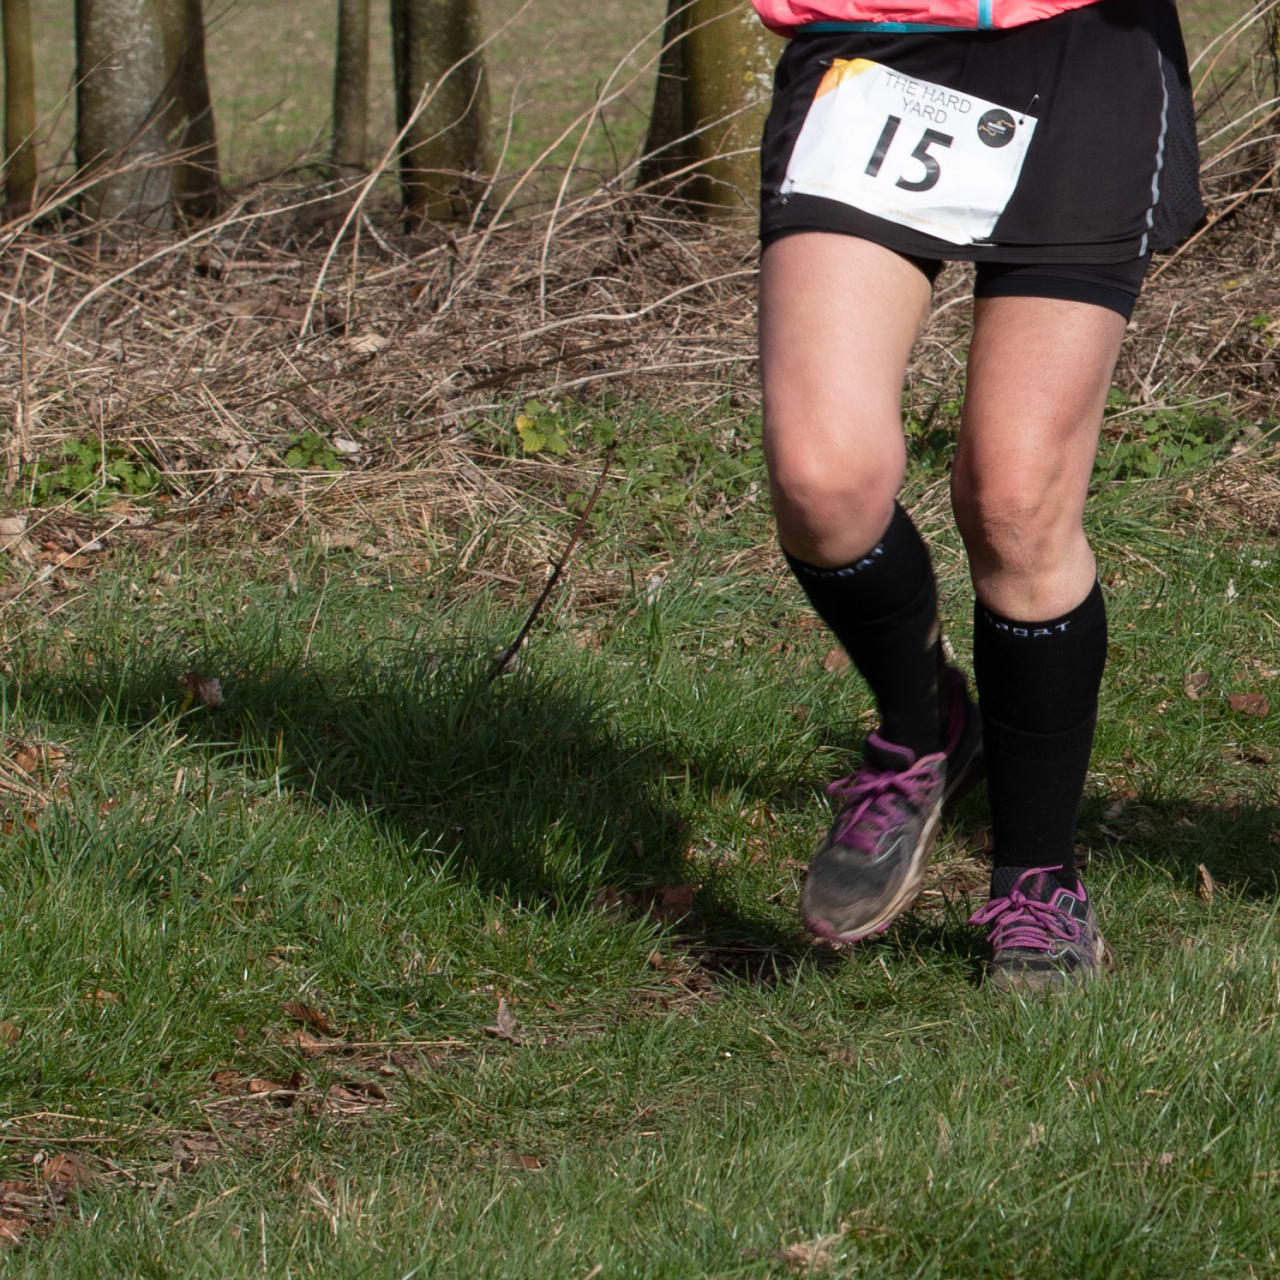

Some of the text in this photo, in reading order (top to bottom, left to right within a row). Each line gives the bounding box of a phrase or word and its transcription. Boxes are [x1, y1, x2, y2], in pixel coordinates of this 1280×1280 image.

[886, 72, 972, 114] THE HARD
[903, 97, 947, 124] YARD
[864, 114, 954, 192] 15
